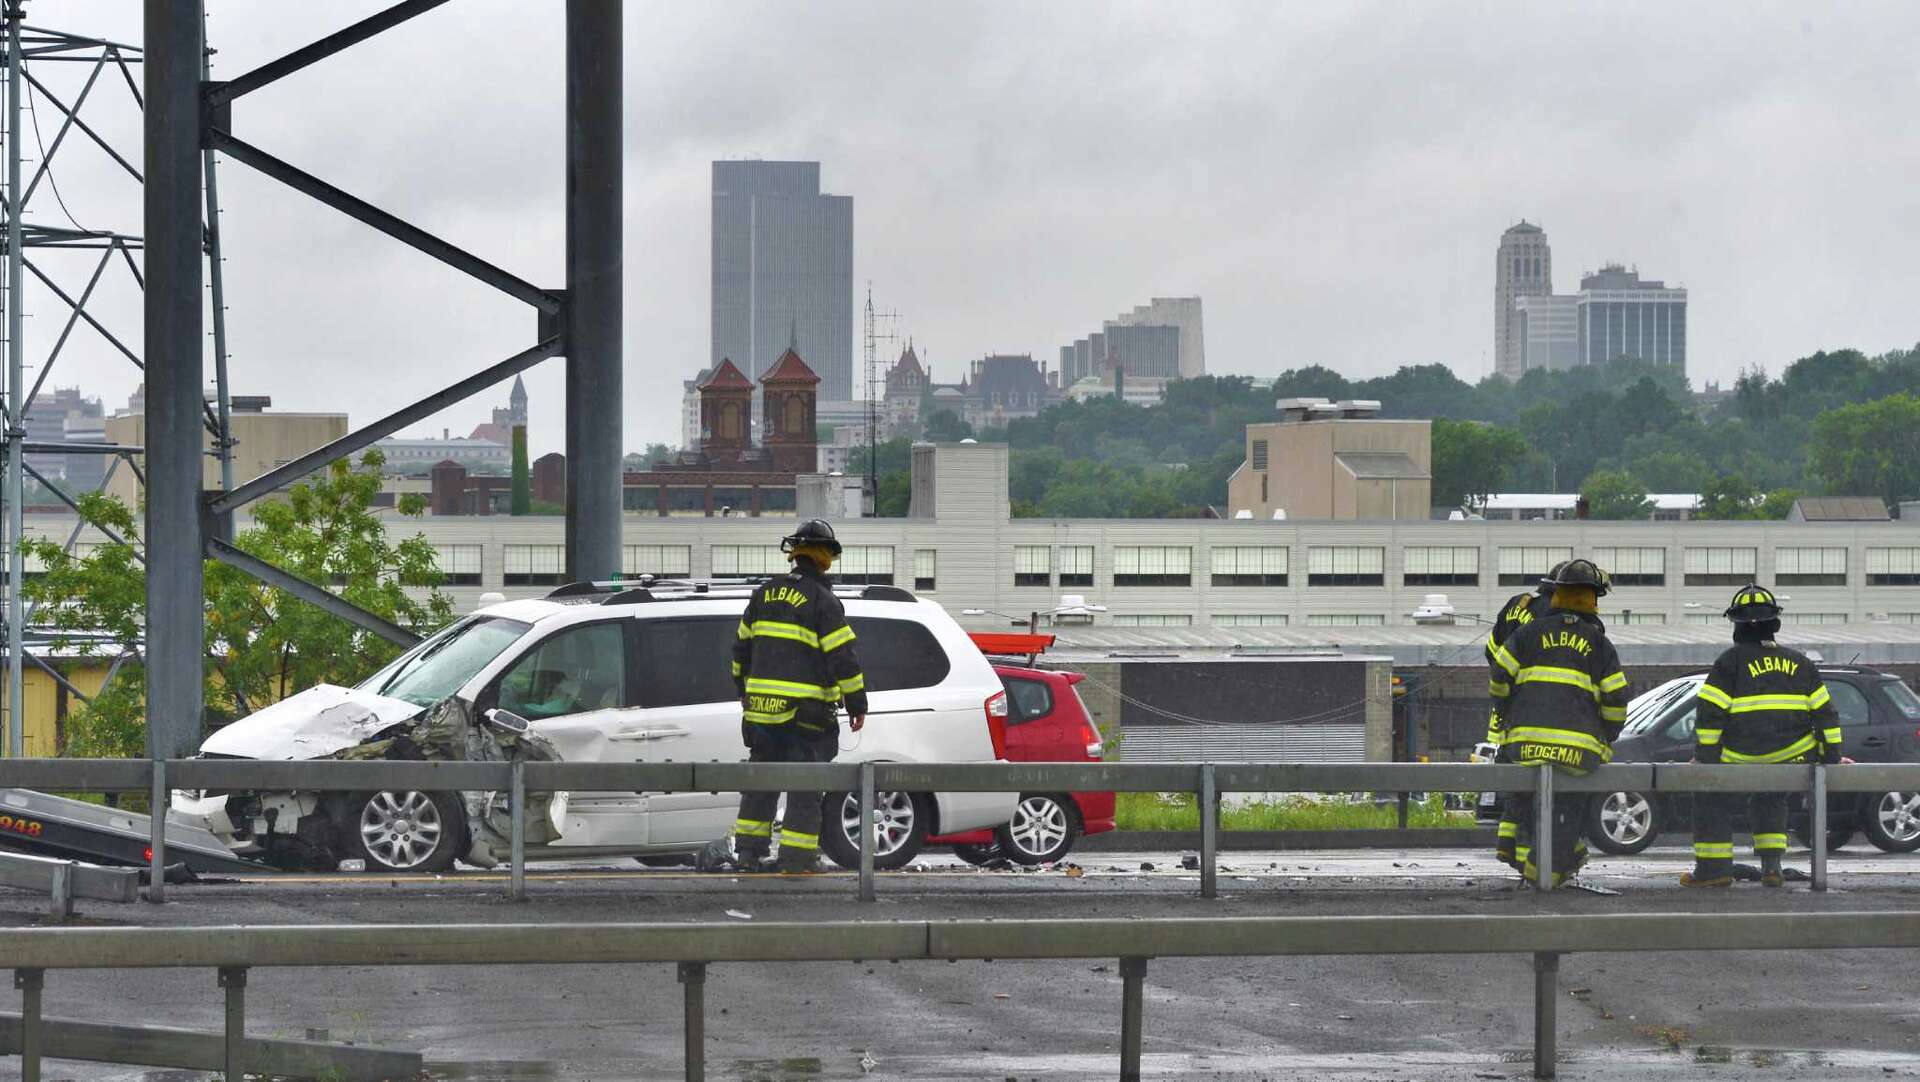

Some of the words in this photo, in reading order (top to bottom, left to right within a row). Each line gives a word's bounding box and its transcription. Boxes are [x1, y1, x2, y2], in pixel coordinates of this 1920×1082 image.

[764, 586, 808, 608] ALBANY
[1506, 605, 1534, 624] ALBAN
[1541, 631, 1592, 657] ALBANY
[1747, 656, 1799, 678] ALBANY
[1520, 744, 1584, 767] HEDGEMAN
